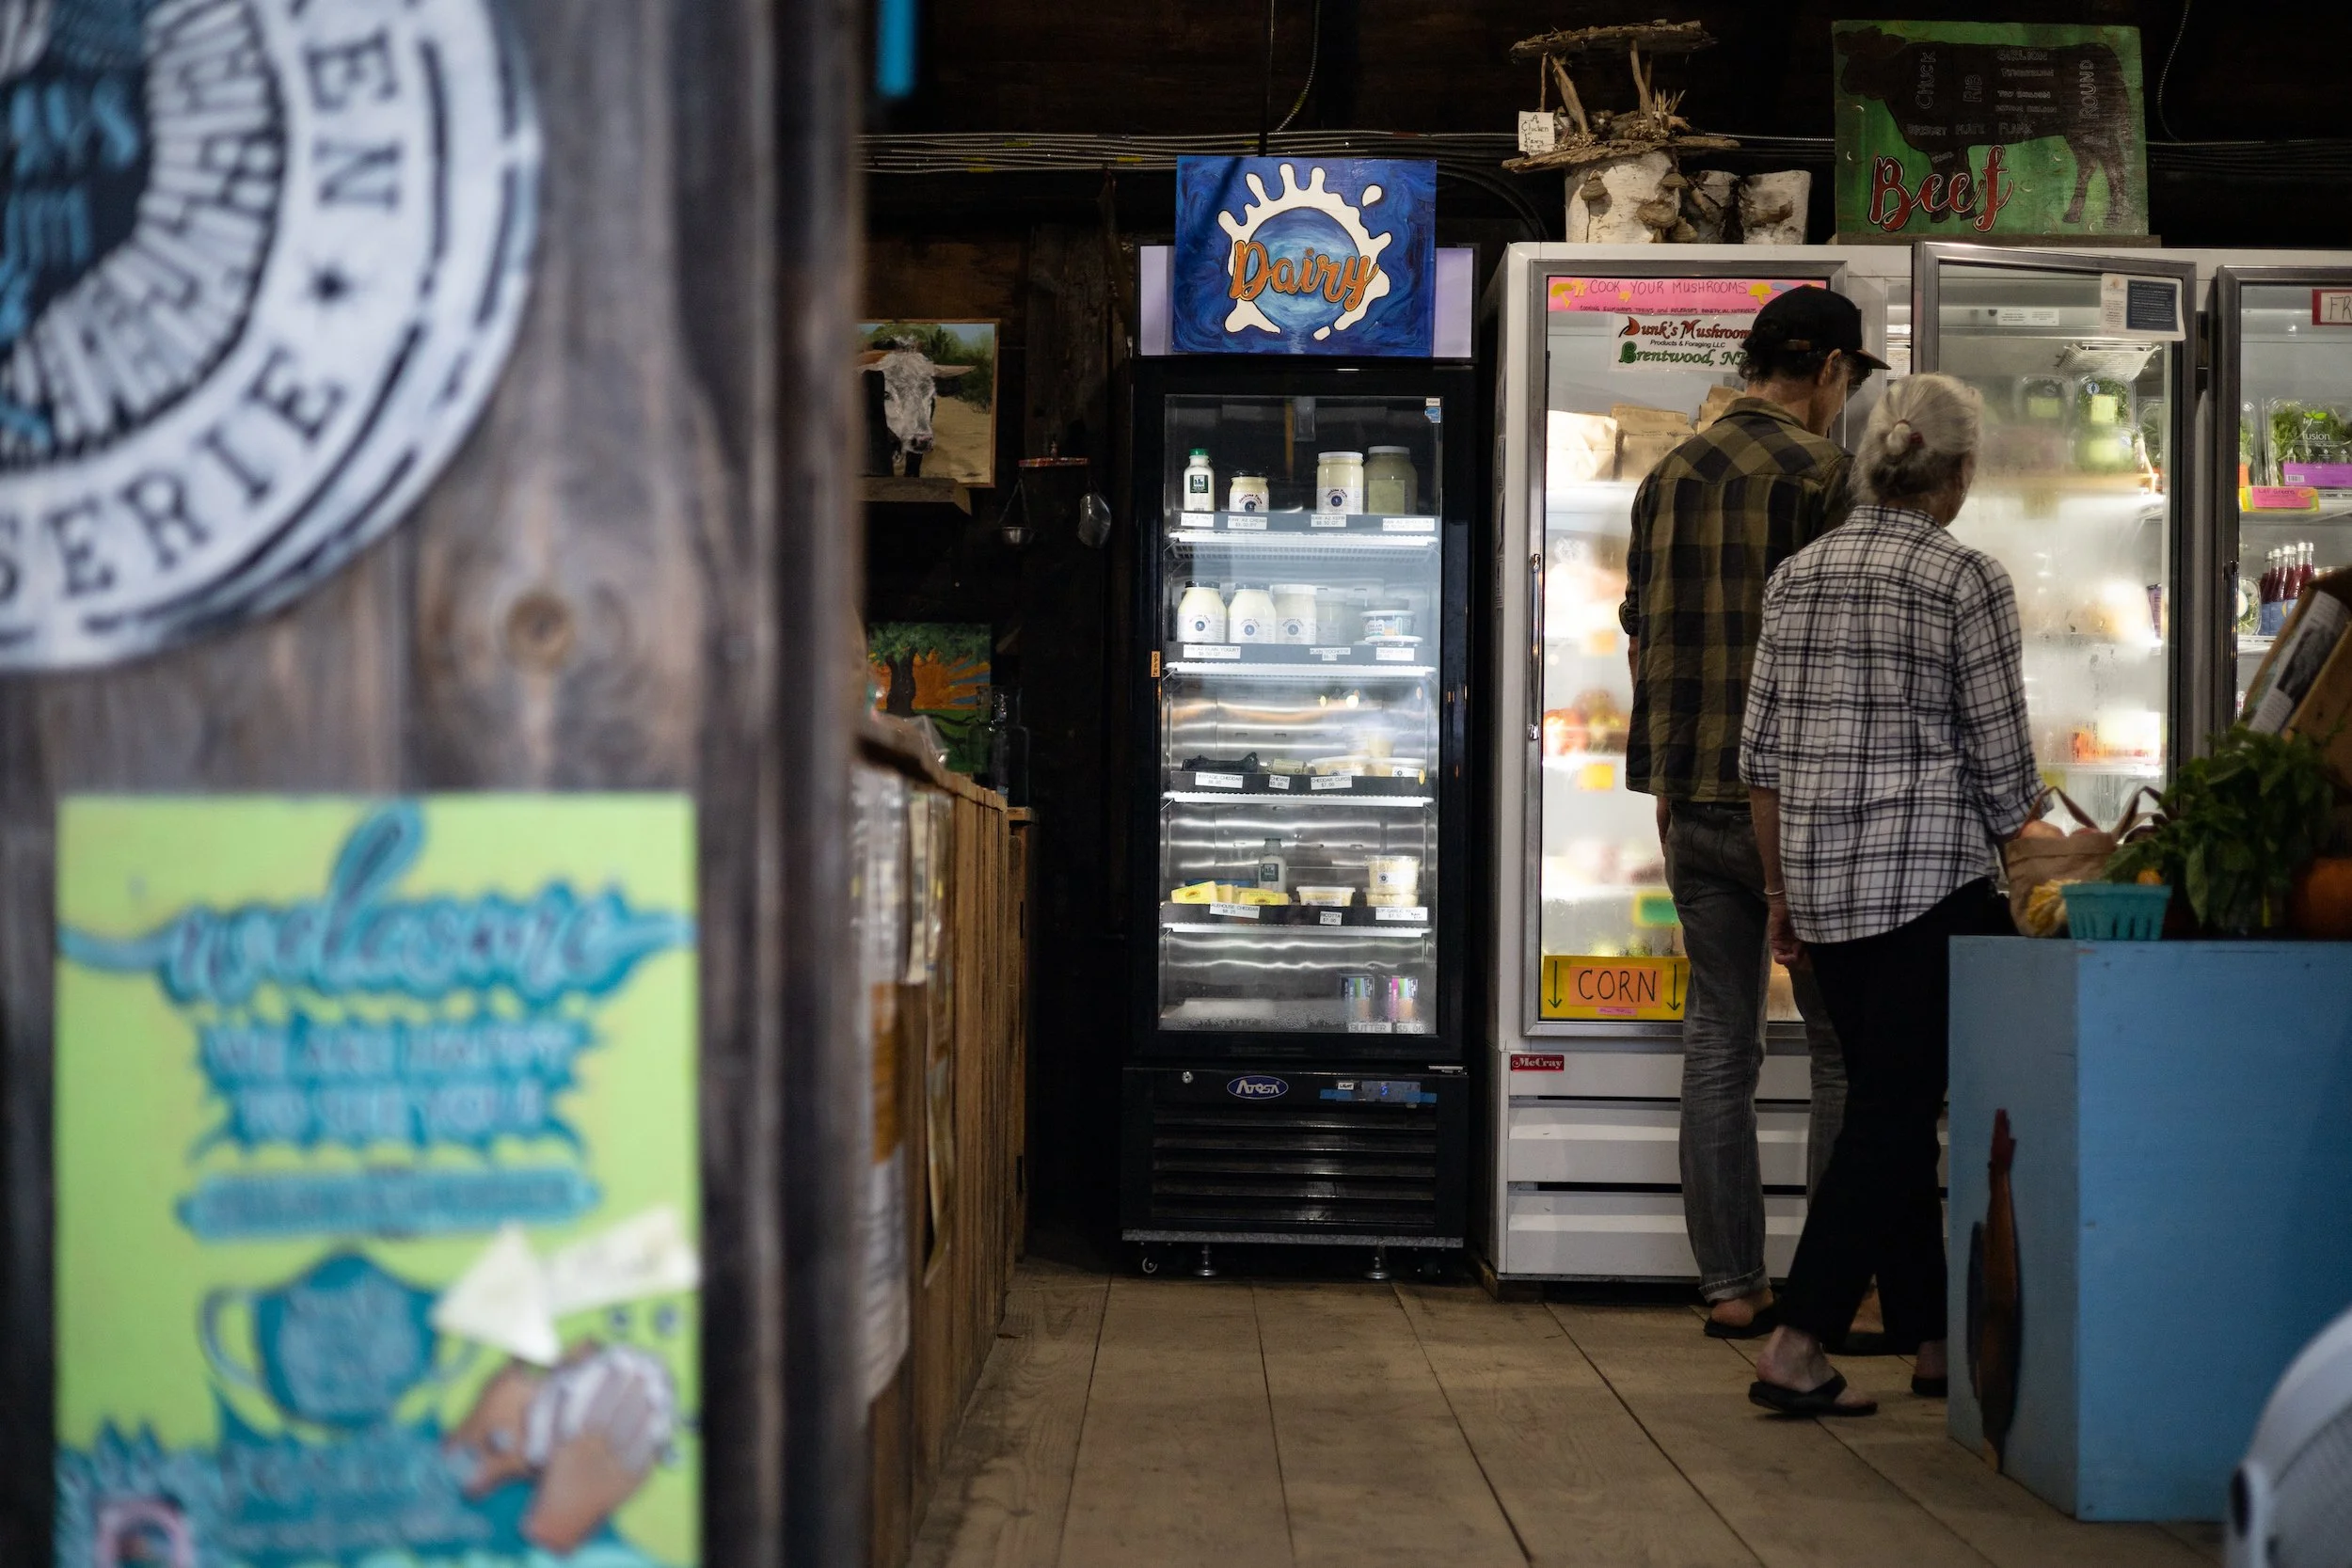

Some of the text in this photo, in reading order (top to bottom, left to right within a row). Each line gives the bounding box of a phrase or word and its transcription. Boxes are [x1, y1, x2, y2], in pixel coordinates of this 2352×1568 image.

[1915, 51, 1936, 109] CHUCK
[1963, 74, 1982, 103] RIB
[2078, 59, 2099, 119] ROUND
[292, 0, 402, 214] EN
[1867, 145, 2014, 233] Beef
[1228, 239, 1380, 312] Dairy
[1589, 278, 1748, 295] COOK YOUR MUSHROOMS
[1618, 315, 1679, 340] Dunk's
[1618, 341, 1717, 367] Brentwood,
[1685, 341, 1711, 349] Foraging
[1578, 969, 1657, 1003] CORN
[1349, 1023, 1387, 1033] BUTTER
[1512, 1057, 1563, 1069] McCray
